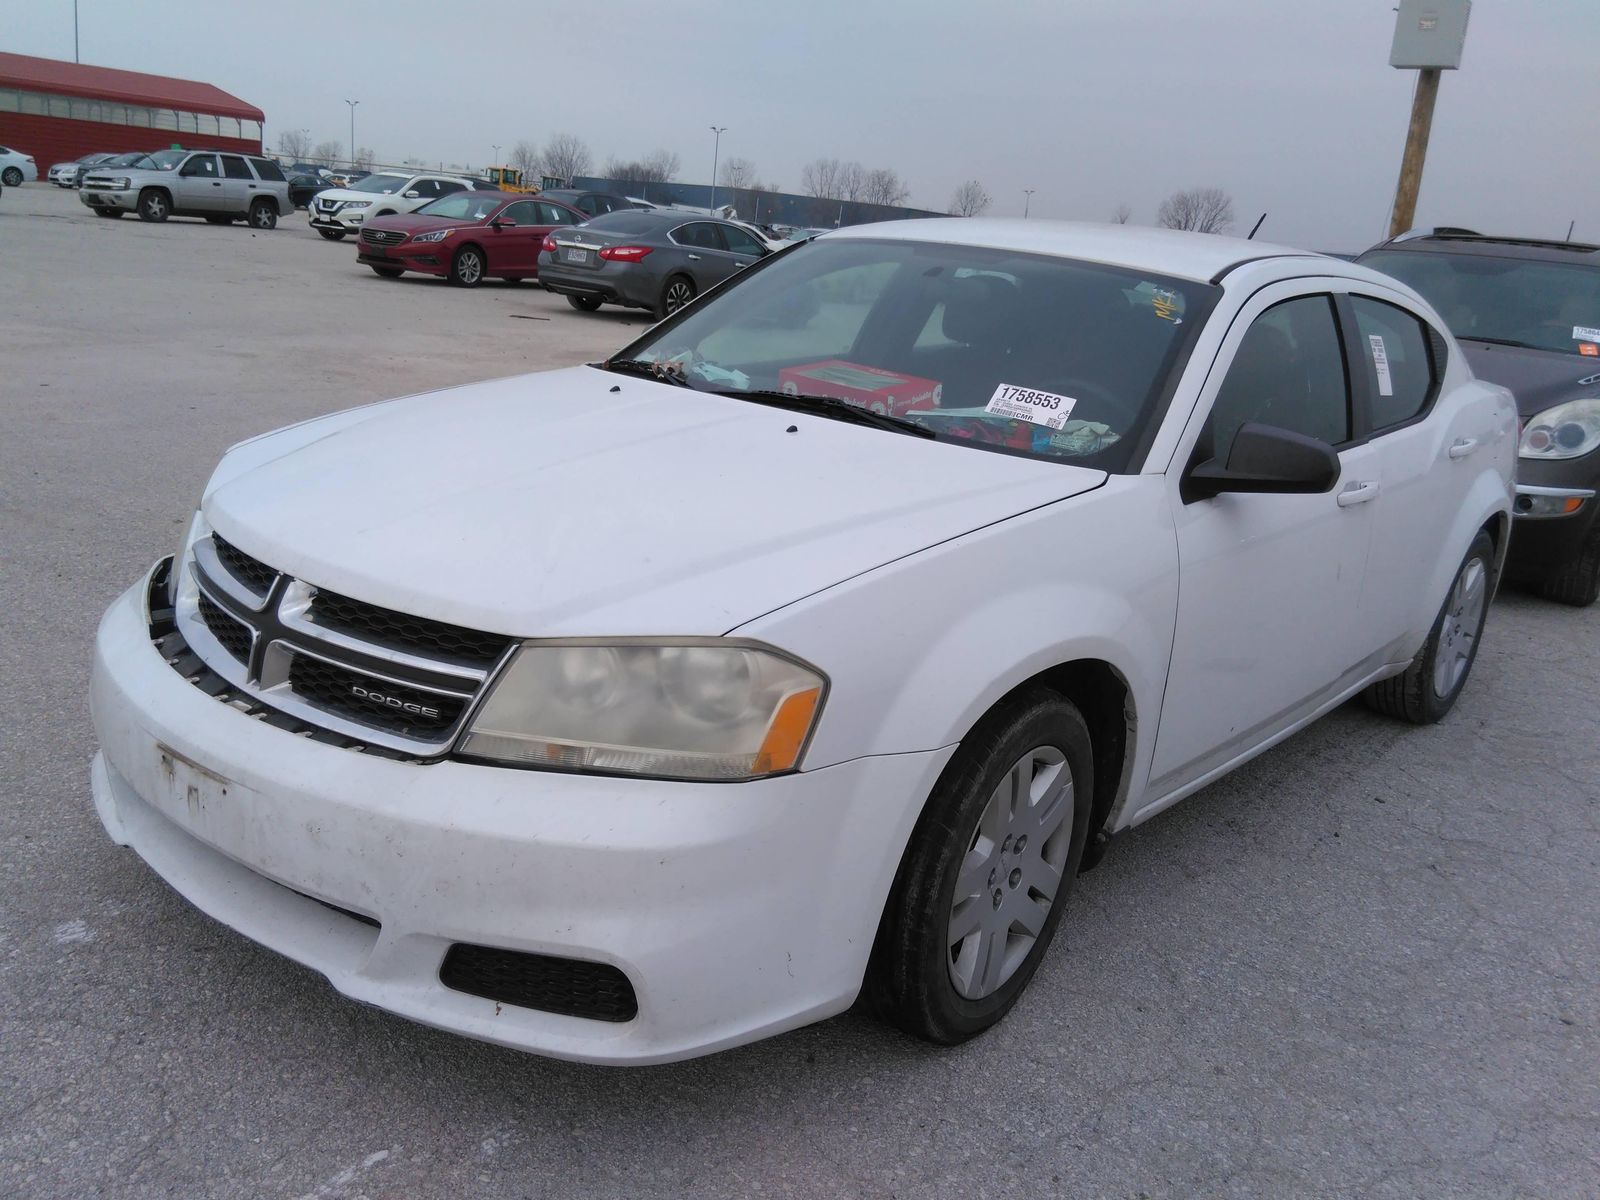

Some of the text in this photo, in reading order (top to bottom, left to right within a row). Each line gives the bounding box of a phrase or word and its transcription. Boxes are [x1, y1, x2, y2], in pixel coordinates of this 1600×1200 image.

[1001, 387, 1061, 410] 1758553
[1015, 412, 1034, 421] CMR
[352, 686, 439, 718] DODGE
